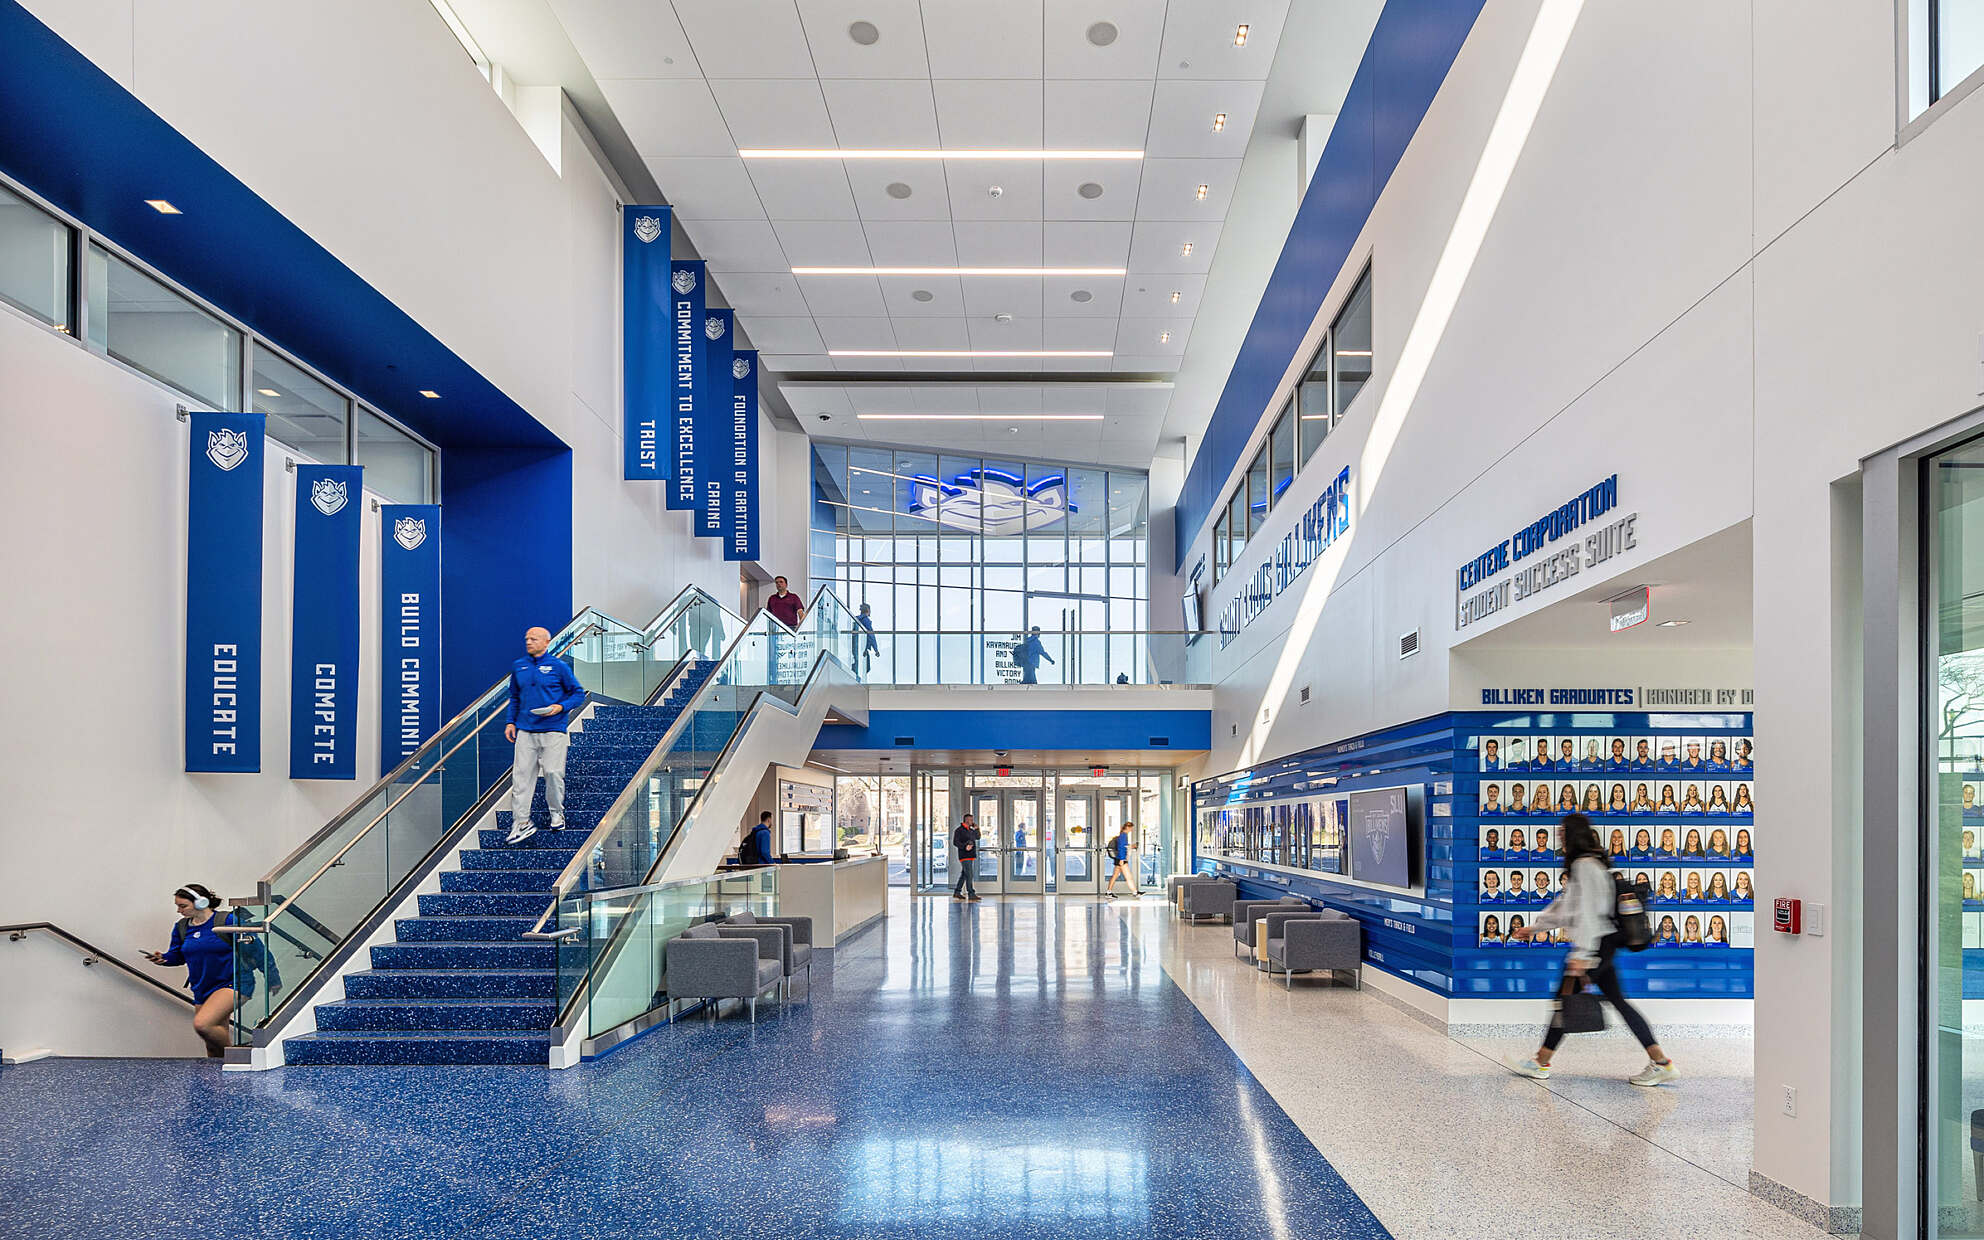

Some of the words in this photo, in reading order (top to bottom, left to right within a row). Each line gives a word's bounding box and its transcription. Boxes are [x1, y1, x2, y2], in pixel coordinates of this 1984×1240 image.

[677, 301, 692, 389] COMMITMENT
[679, 395, 693, 412] TO
[734, 395, 747, 466] FOUNDATION
[640, 420, 656, 470] TRUST
[679, 417, 694, 501] EXCELLENCE
[707, 481, 720, 529] CARING
[735, 471, 747, 485] OF
[735, 491, 748, 553] GRATITUDE
[1460, 539, 1510, 591] CENTENE
[1512, 473, 1618, 562] CORPORATION
[1219, 591, 1242, 652] SAINT
[1244, 556, 1273, 628] LOUIS
[1275, 464, 1350, 597] BILLIKENS
[1460, 578, 1511, 627] STUDENT
[1514, 543, 1580, 602] SUCCESS
[1585, 512, 1637, 569] SUITE
[402, 593, 420, 647] BUILD
[995, 650, 1008, 658] AND
[996, 669, 1021, 678] VICTORY
[212, 643, 237, 755] EDUCATE
[313, 663, 336, 764] COMPETE
[1481, 688, 1545, 705] BILLIKEN
[1550, 688, 1634, 705] GRADUATES
[1647, 689, 1712, 705] HONORED
[1717, 689, 1736, 705] BY
[1776, 900, 1790, 908] FIRE
